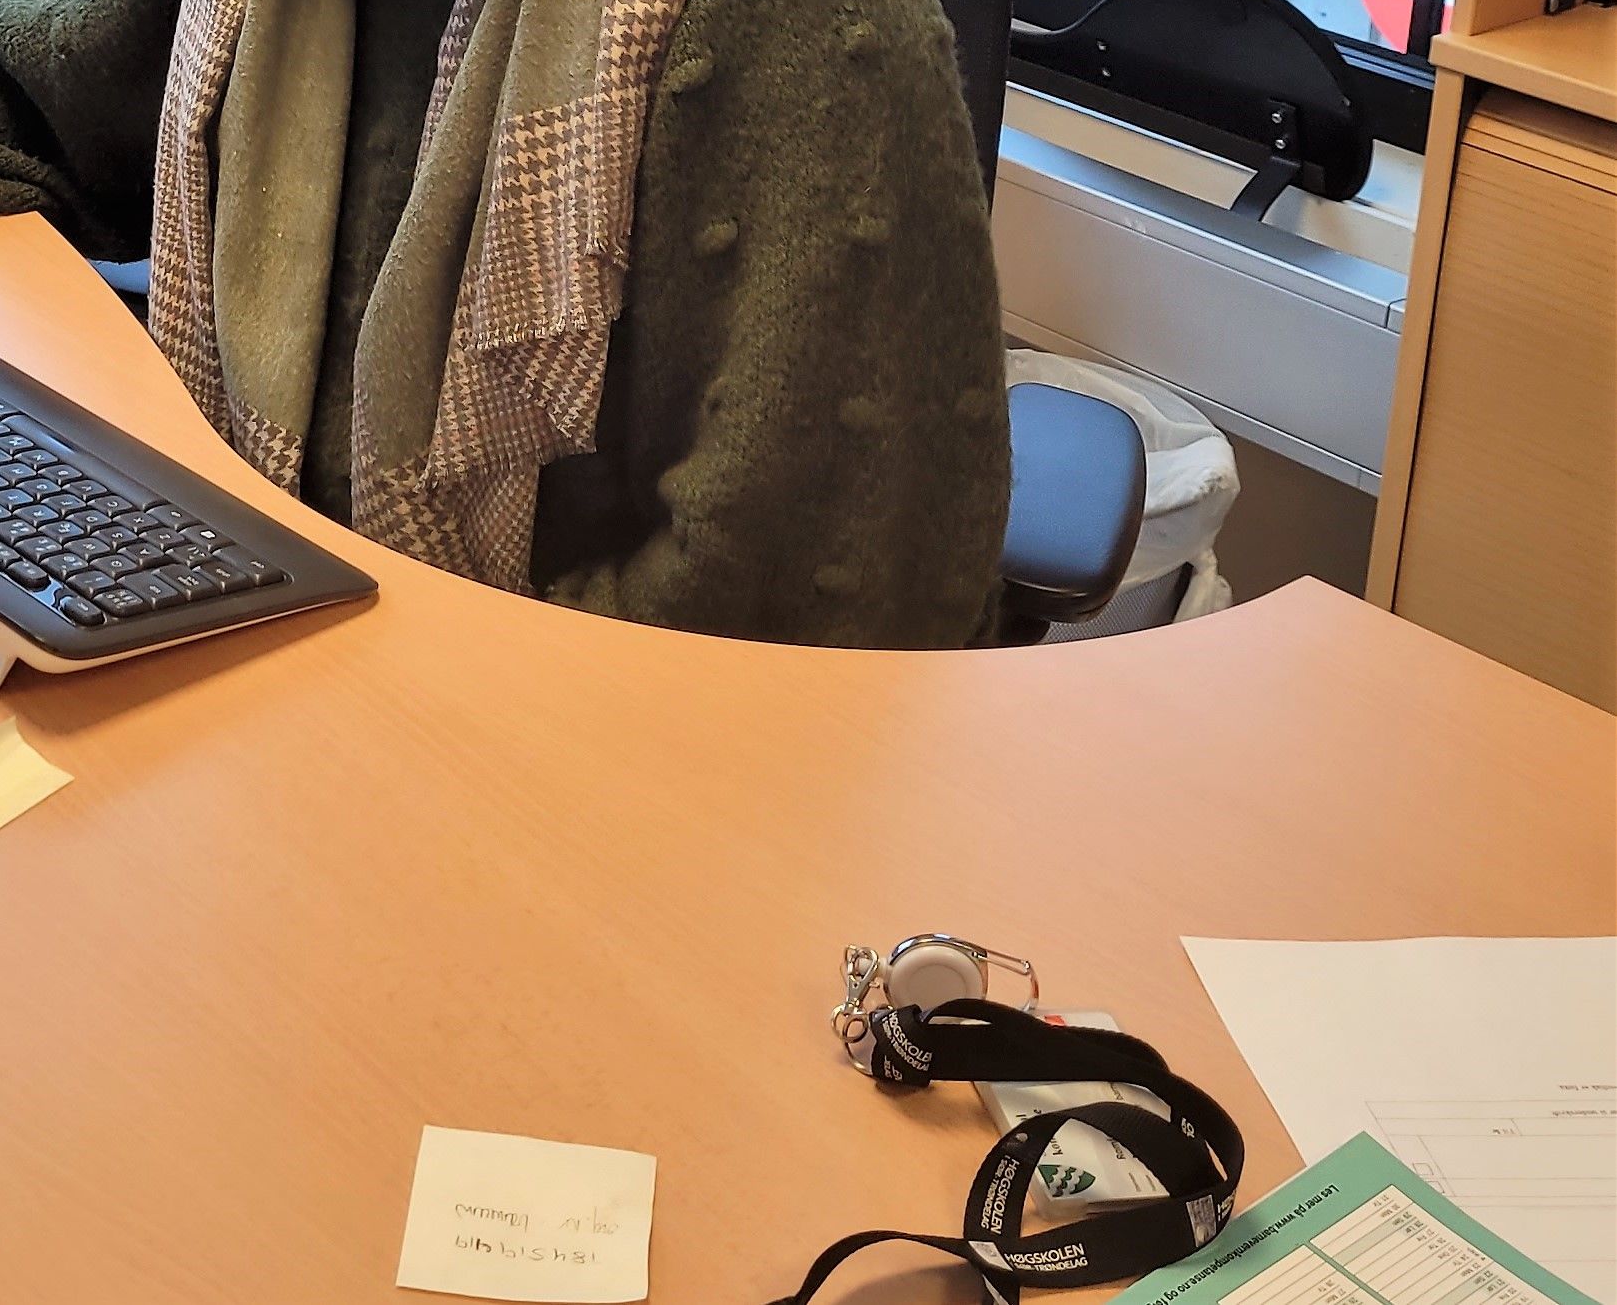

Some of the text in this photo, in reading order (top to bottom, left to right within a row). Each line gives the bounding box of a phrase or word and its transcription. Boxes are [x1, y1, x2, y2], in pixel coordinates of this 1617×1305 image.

[990, 1158, 1020, 1235] HØGSKOLEN
[1321, 1184, 1340, 1198] Les
[1305, 1195, 1323, 1210] mer
[1294, 1204, 1307, 1218] på
[1004, 1242, 1085, 1265] HØGSKOLEN
[1163, 1290, 1179, 1302] og
